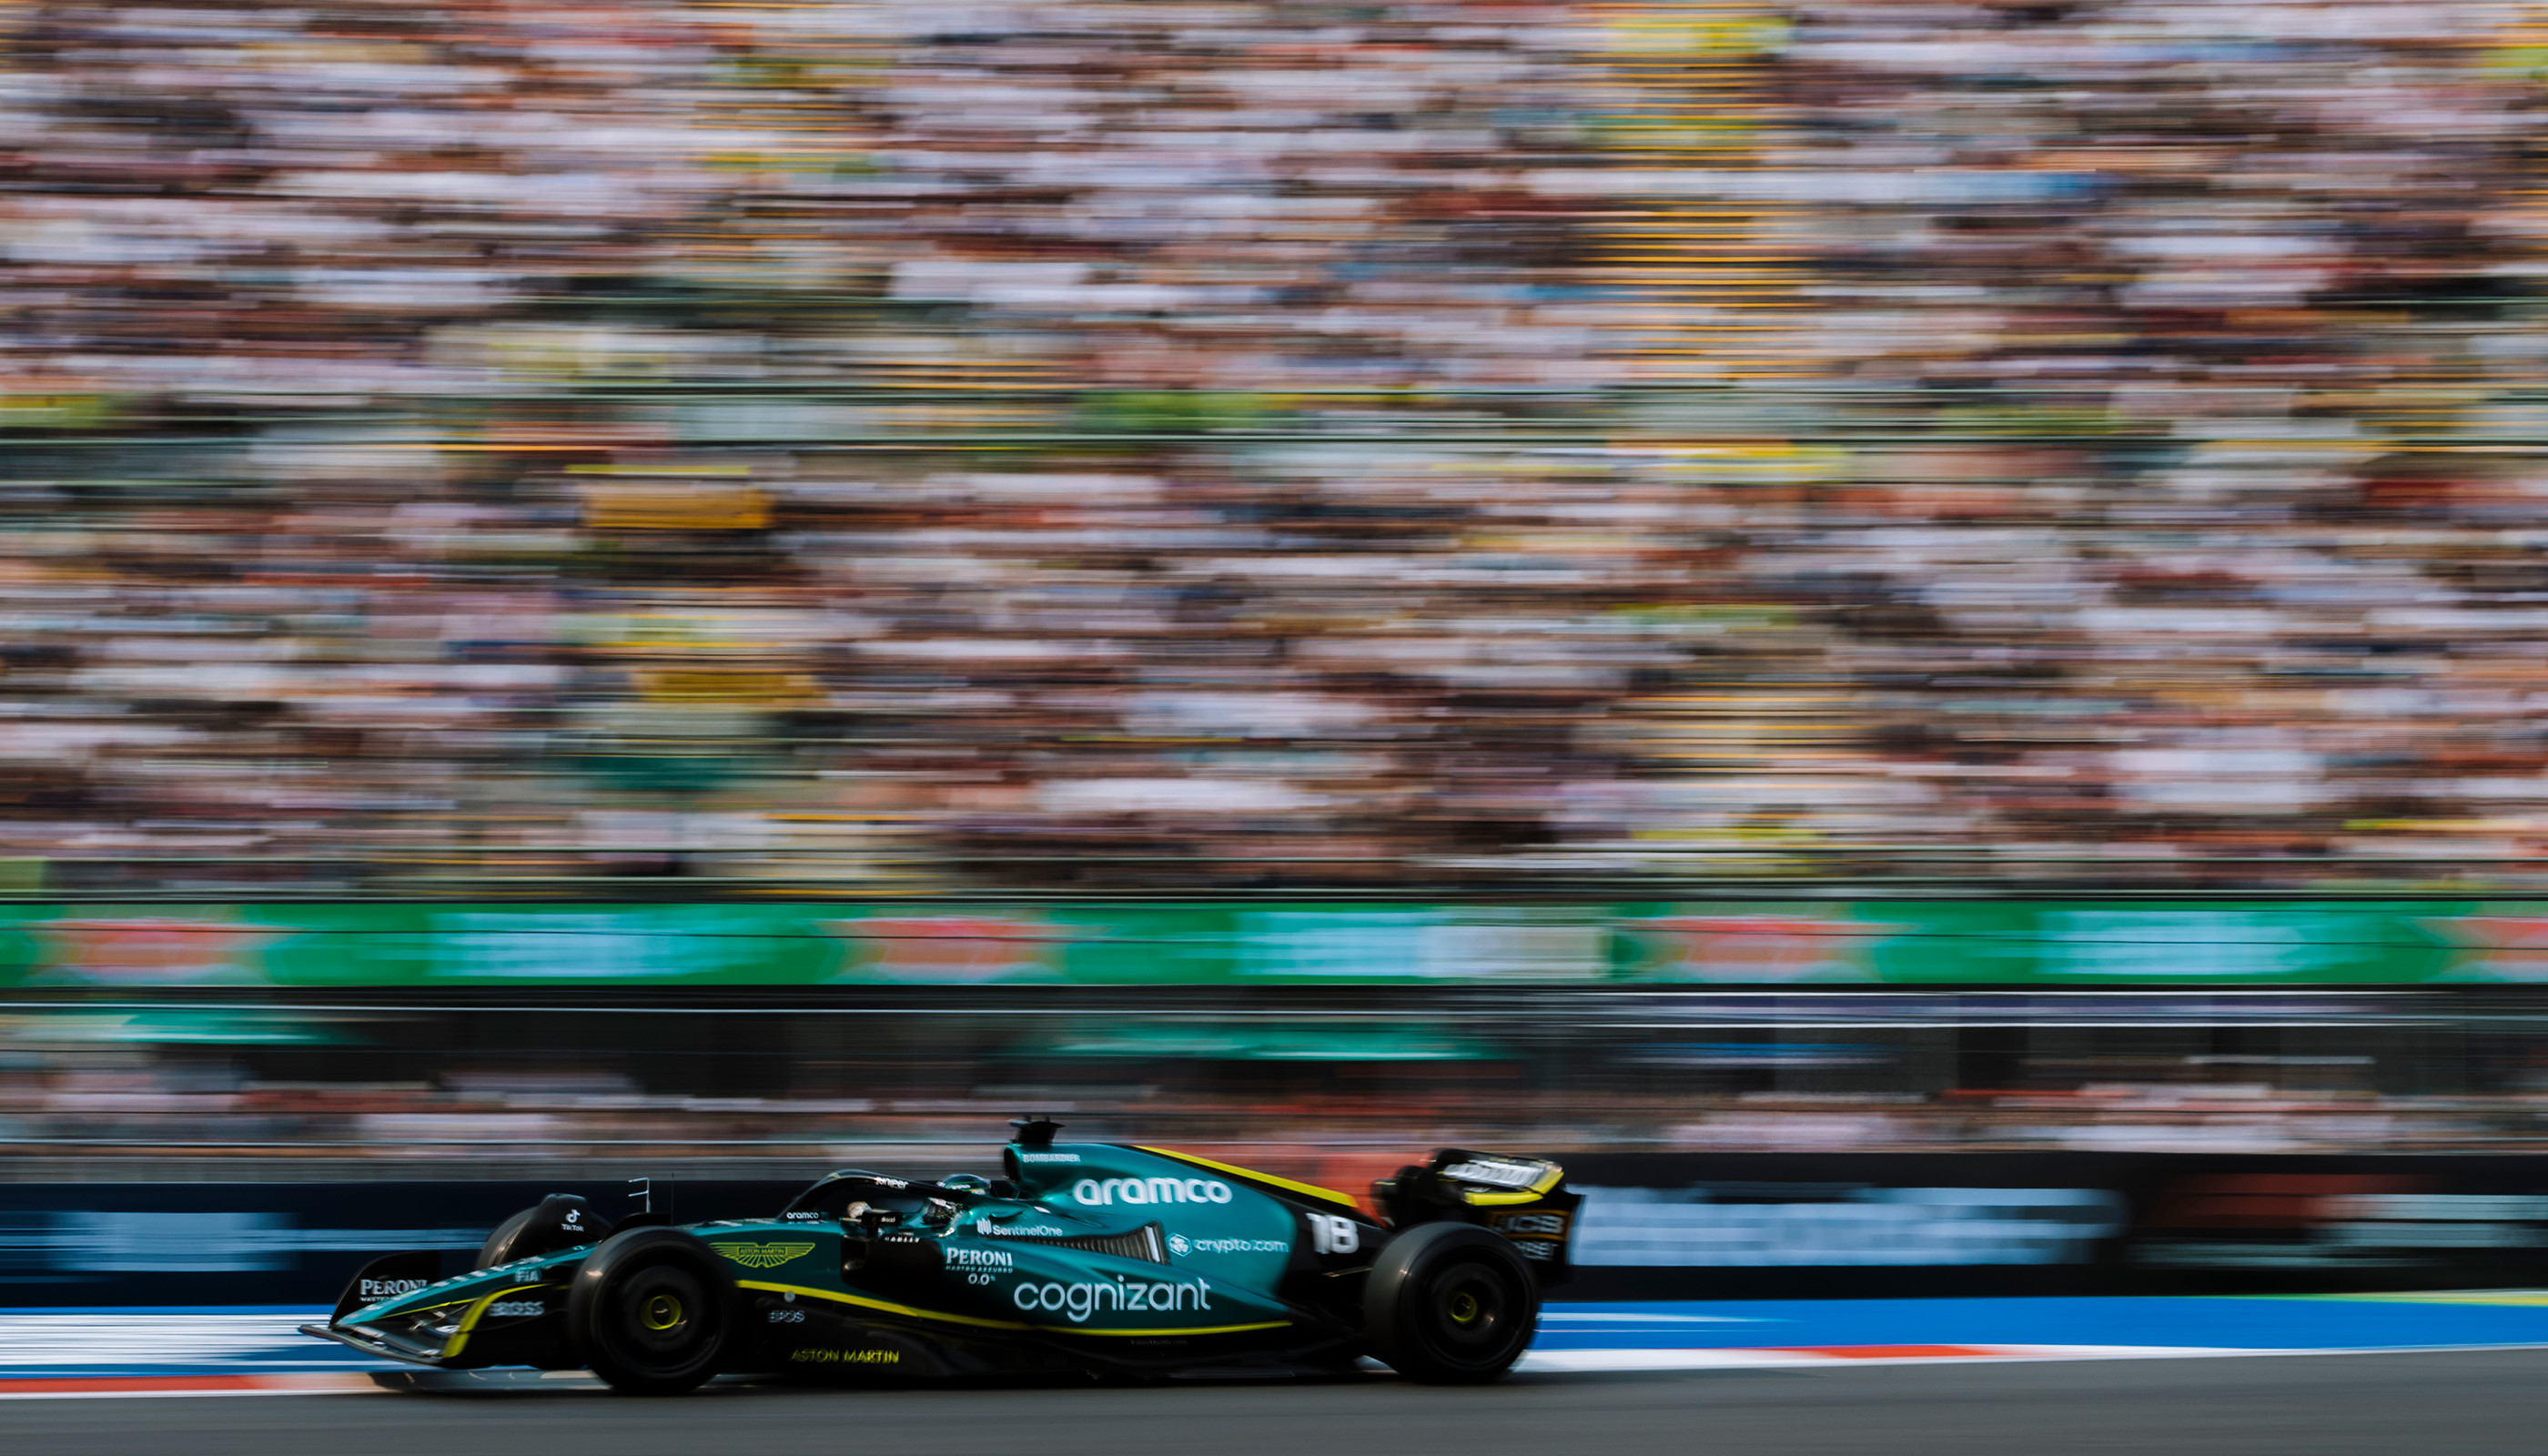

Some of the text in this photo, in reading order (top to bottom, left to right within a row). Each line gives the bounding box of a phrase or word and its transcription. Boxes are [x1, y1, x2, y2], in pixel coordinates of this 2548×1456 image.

[1022, 1154, 1080, 1163] BOMBARDIER
[1073, 1178, 1232, 1205] aramco
[786, 1211, 819, 1219] aramco
[561, 1223, 584, 1231] TikTok
[993, 1225, 1063, 1236] SentinelOne
[1305, 1212, 1360, 1254] 18
[1193, 1239, 1289, 1254] crypto.com
[946, 1247, 1013, 1266] PERONI
[516, 1270, 539, 1282] FIA
[1014, 1275, 1210, 1322] cognizant
[768, 1310, 805, 1322] EPOS
[791, 1349, 899, 1363] ASTON MARTIN
